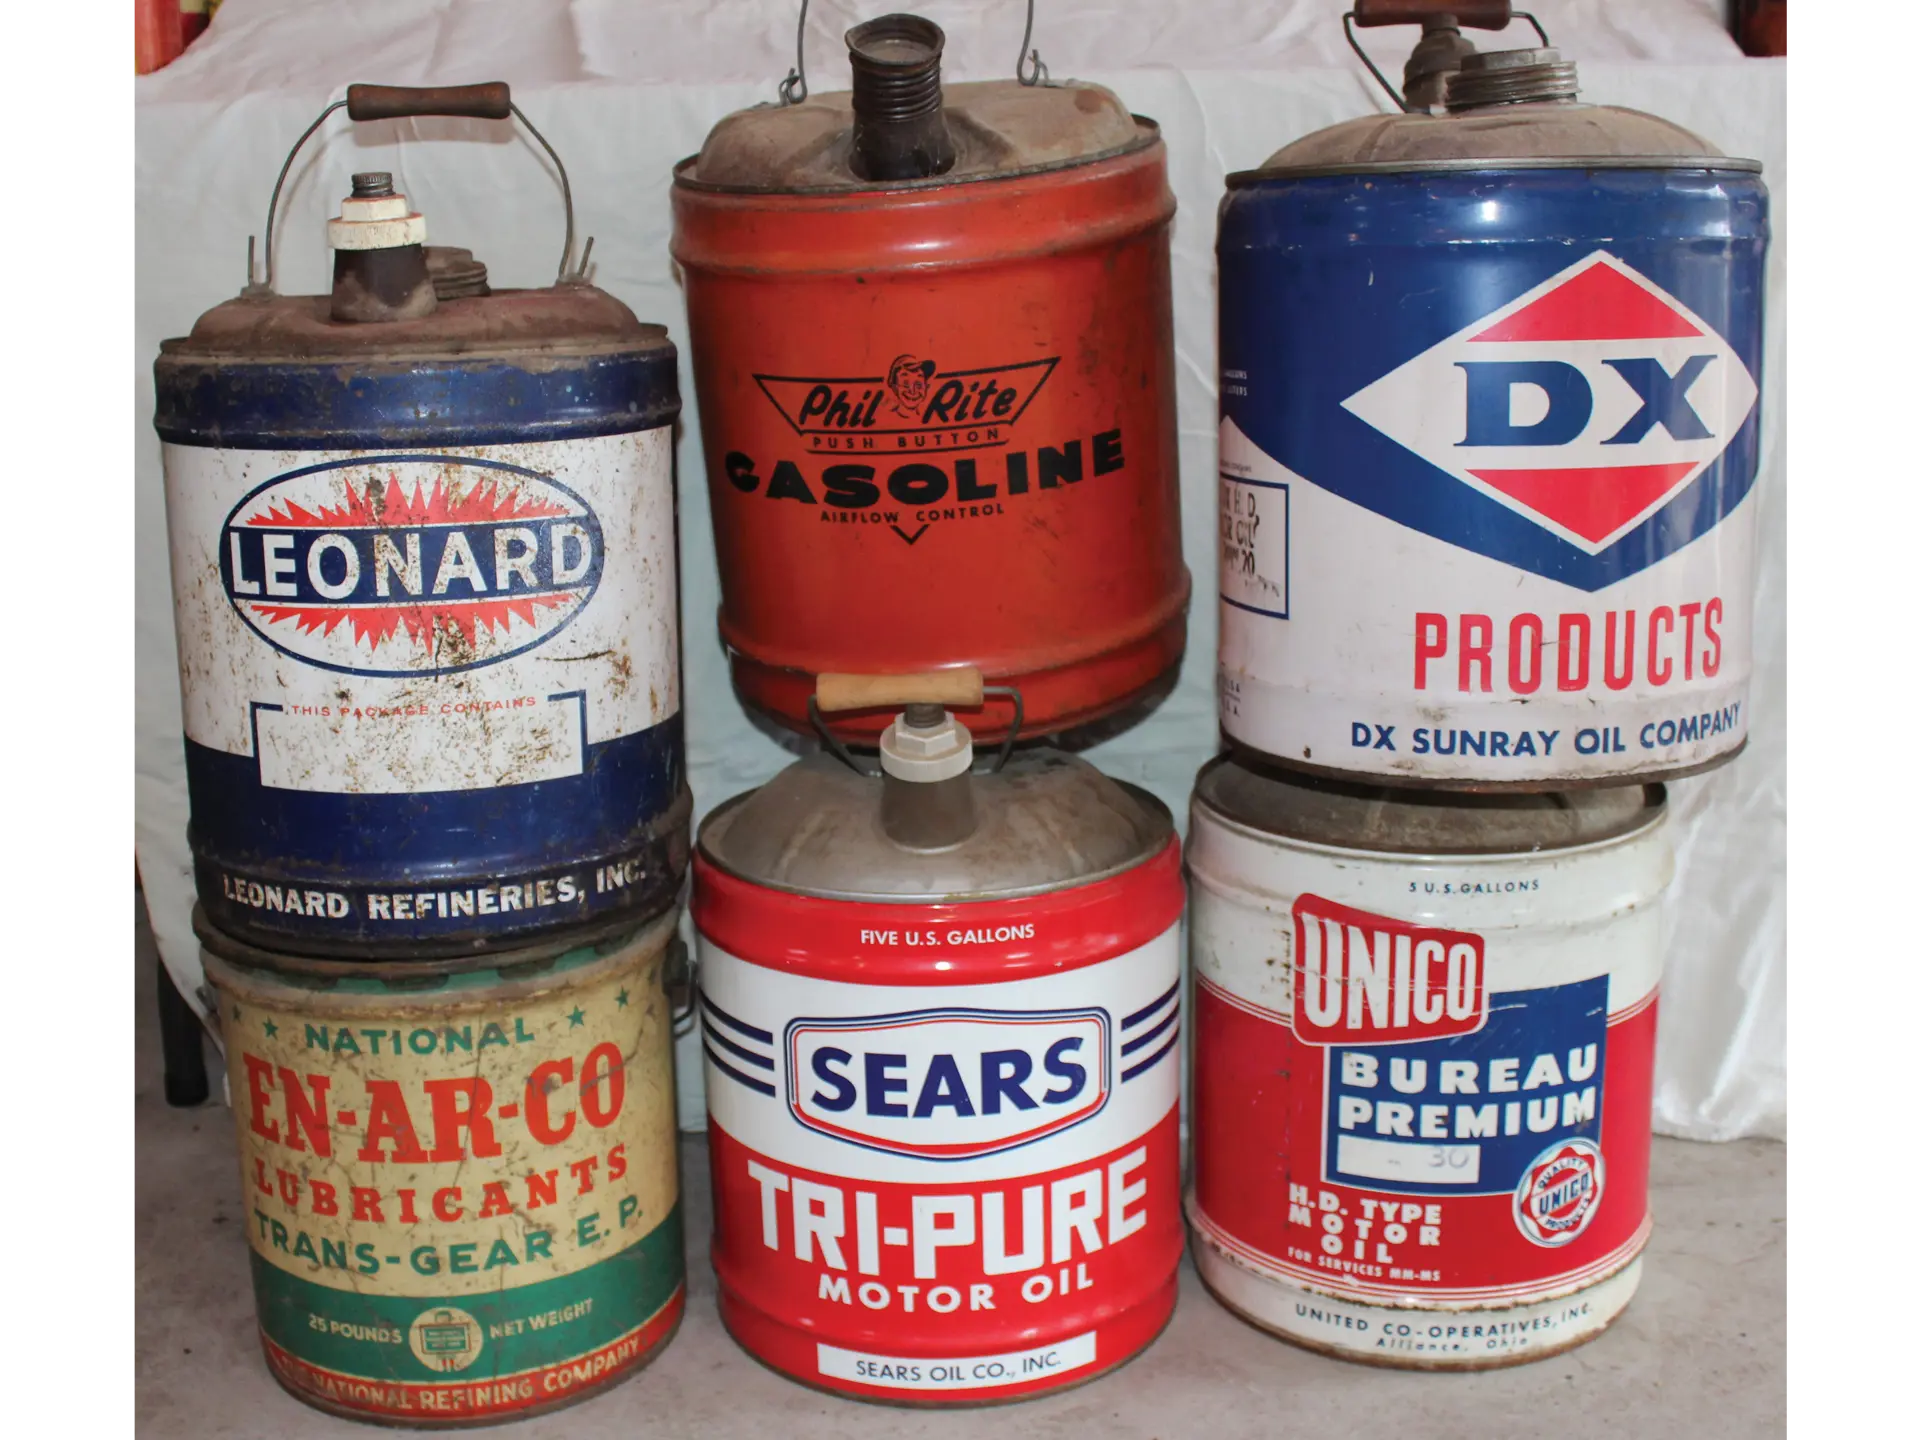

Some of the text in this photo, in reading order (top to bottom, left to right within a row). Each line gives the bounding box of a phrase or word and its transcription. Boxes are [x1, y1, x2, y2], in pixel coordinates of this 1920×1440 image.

[800, 379, 1018, 428] Phil Rite
[1452, 354, 1719, 447] DX
[812, 428, 1000, 450] PUSH BUTTON
[724, 428, 1126, 509] GASOLINE
[820, 503, 1005, 524] AIRFLOW CONTROL
[230, 524, 592, 599] LEONARD
[1413, 596, 1724, 695] PRODUCTS
[291, 696, 537, 720] THIS PACKAGE CONTAINS
[1351, 702, 1742, 758] DX SUNRAY OIL COMPANY
[222, 860, 647, 920] LEONARD REFINERIES, INC.
[1408, 882, 1417, 893] 5
[860, 923, 1035, 947] FIVE U.S. GALLONS
[1301, 911, 1476, 1031] UNICO
[305, 1017, 535, 1056] NATIONAL
[810, 1036, 1088, 1119] SEARS
[1341, 1043, 1598, 1095] BUREAU
[242, 1041, 626, 1165] EN-AR-CO
[1338, 1087, 1596, 1140] PREMIUM
[254, 1144, 629, 1224] LUBRICANTS
[1288, 1183, 1442, 1226] H.D. TYPE
[1538, 1170, 1591, 1216] UNICO
[747, 1145, 1148, 1280] TRI-PURE
[1288, 1206, 1441, 1246] MOTOR
[254, 1210, 553, 1276] TRANS-GEAR
[1287, 1246, 1441, 1282] FOR SERVICES MM-MS
[1320, 1232, 1393, 1264] OIL
[818, 1264, 1094, 1314] MOTOR OIL
[308, 1312, 328, 1333] 25
[330, 1320, 403, 1345] POUNDS
[490, 1321, 524, 1340] NET
[530, 1298, 593, 1332] WEIGHT
[1295, 1301, 1595, 1339] UNITED CO-OPERATIVES, INC.
[311, 1340, 641, 1411] NATIONAL REFINING COMPANY
[856, 1359, 922, 1382] SEARS
[929, 1364, 965, 1382] OIL
[1022, 1350, 1062, 1374] INC.
